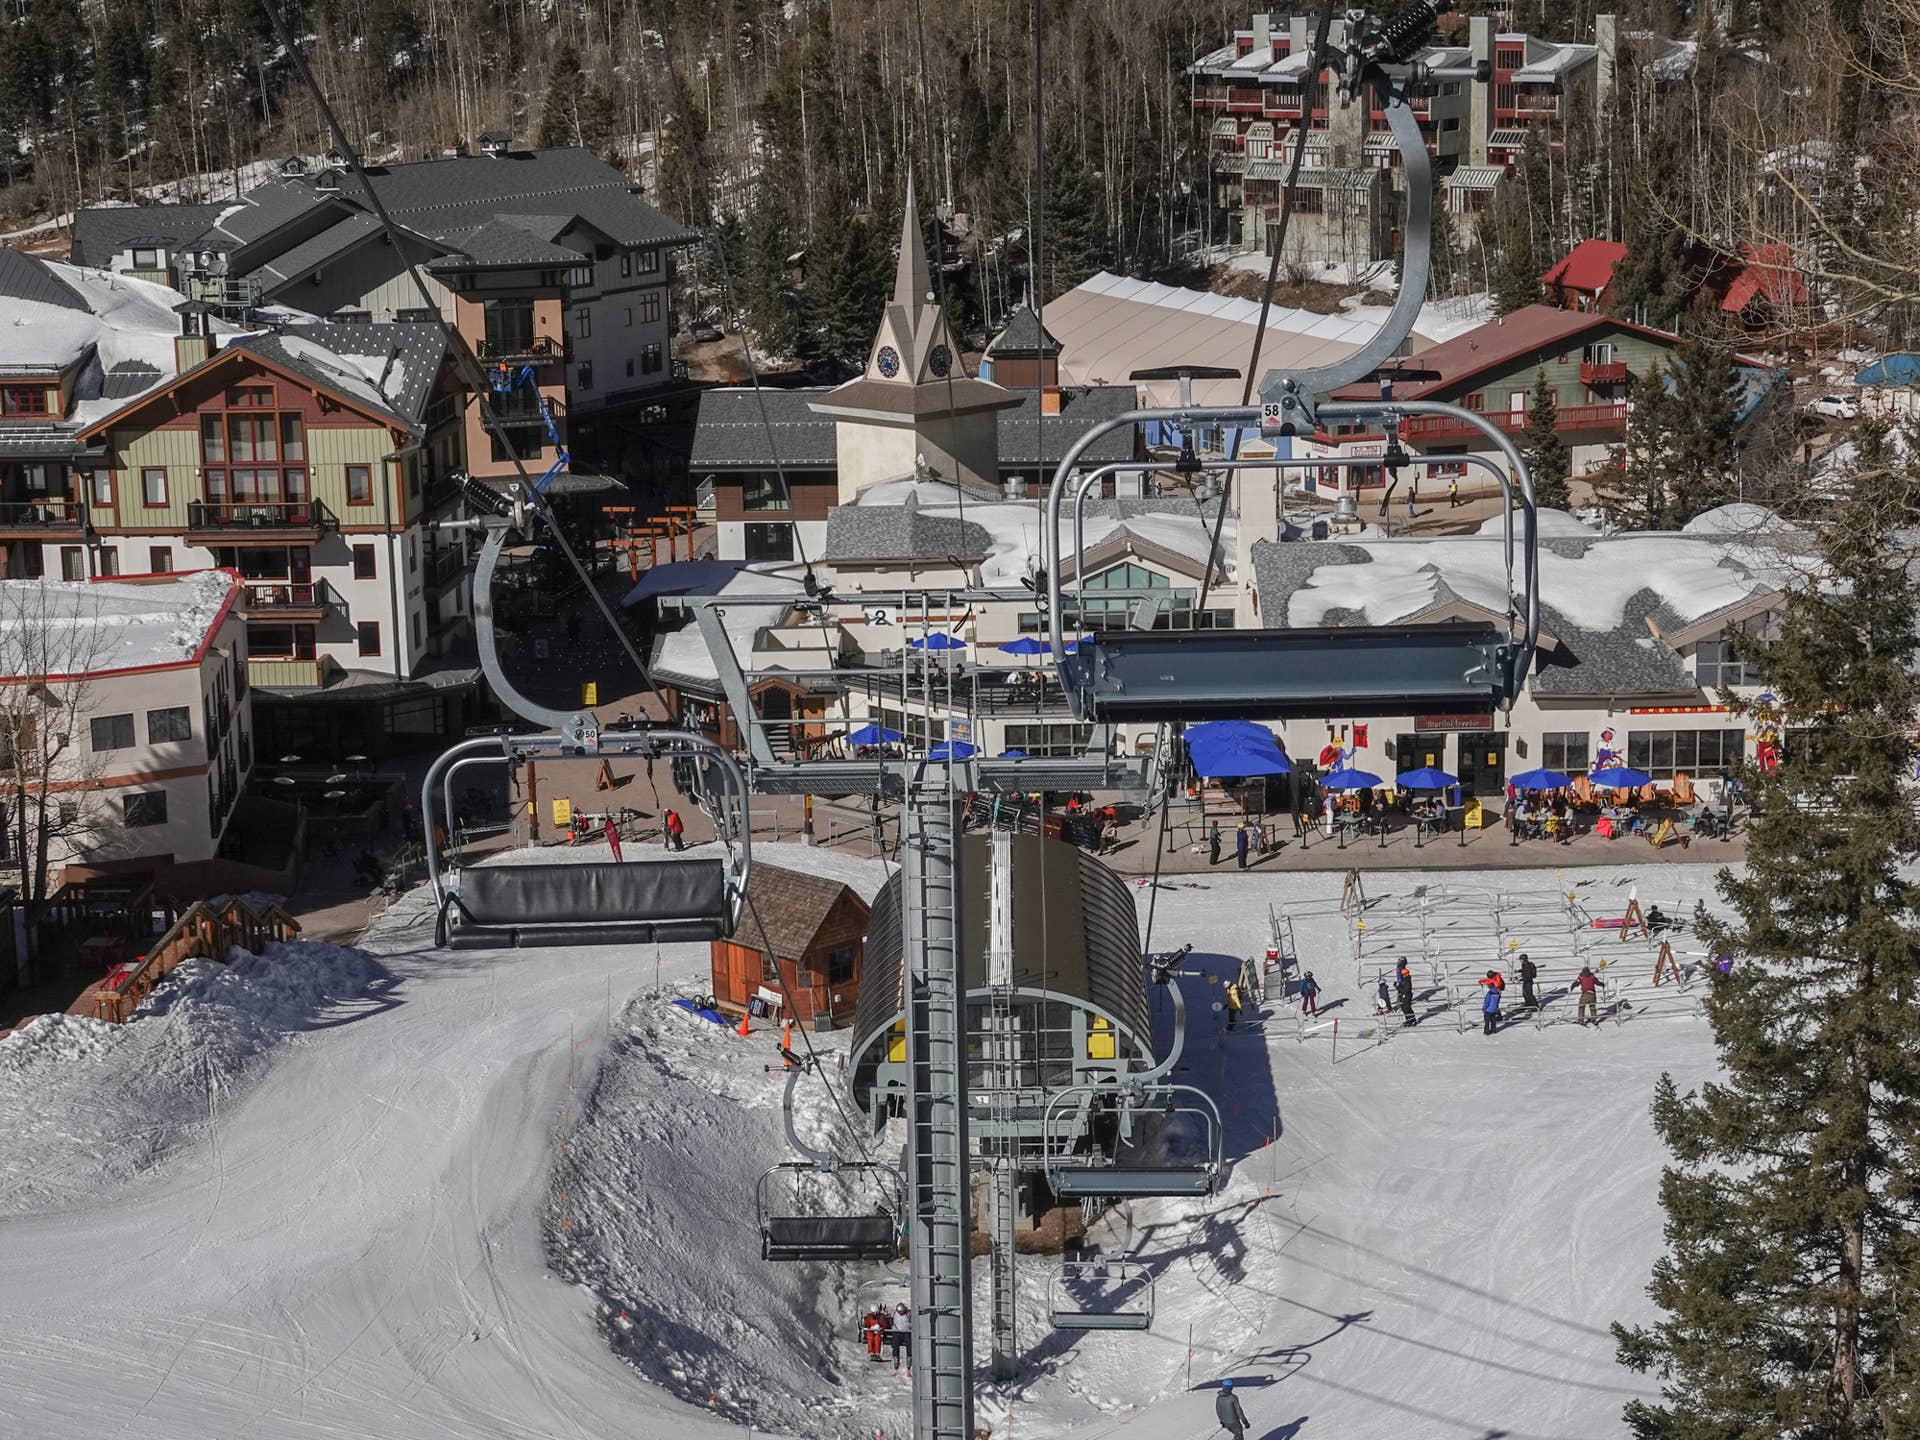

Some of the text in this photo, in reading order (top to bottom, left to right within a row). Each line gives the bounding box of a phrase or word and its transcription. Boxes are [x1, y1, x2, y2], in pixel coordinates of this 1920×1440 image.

[1265, 405, 1279, 416] 58
[875, 610, 886, 625] 2
[585, 730, 595, 738] 50
